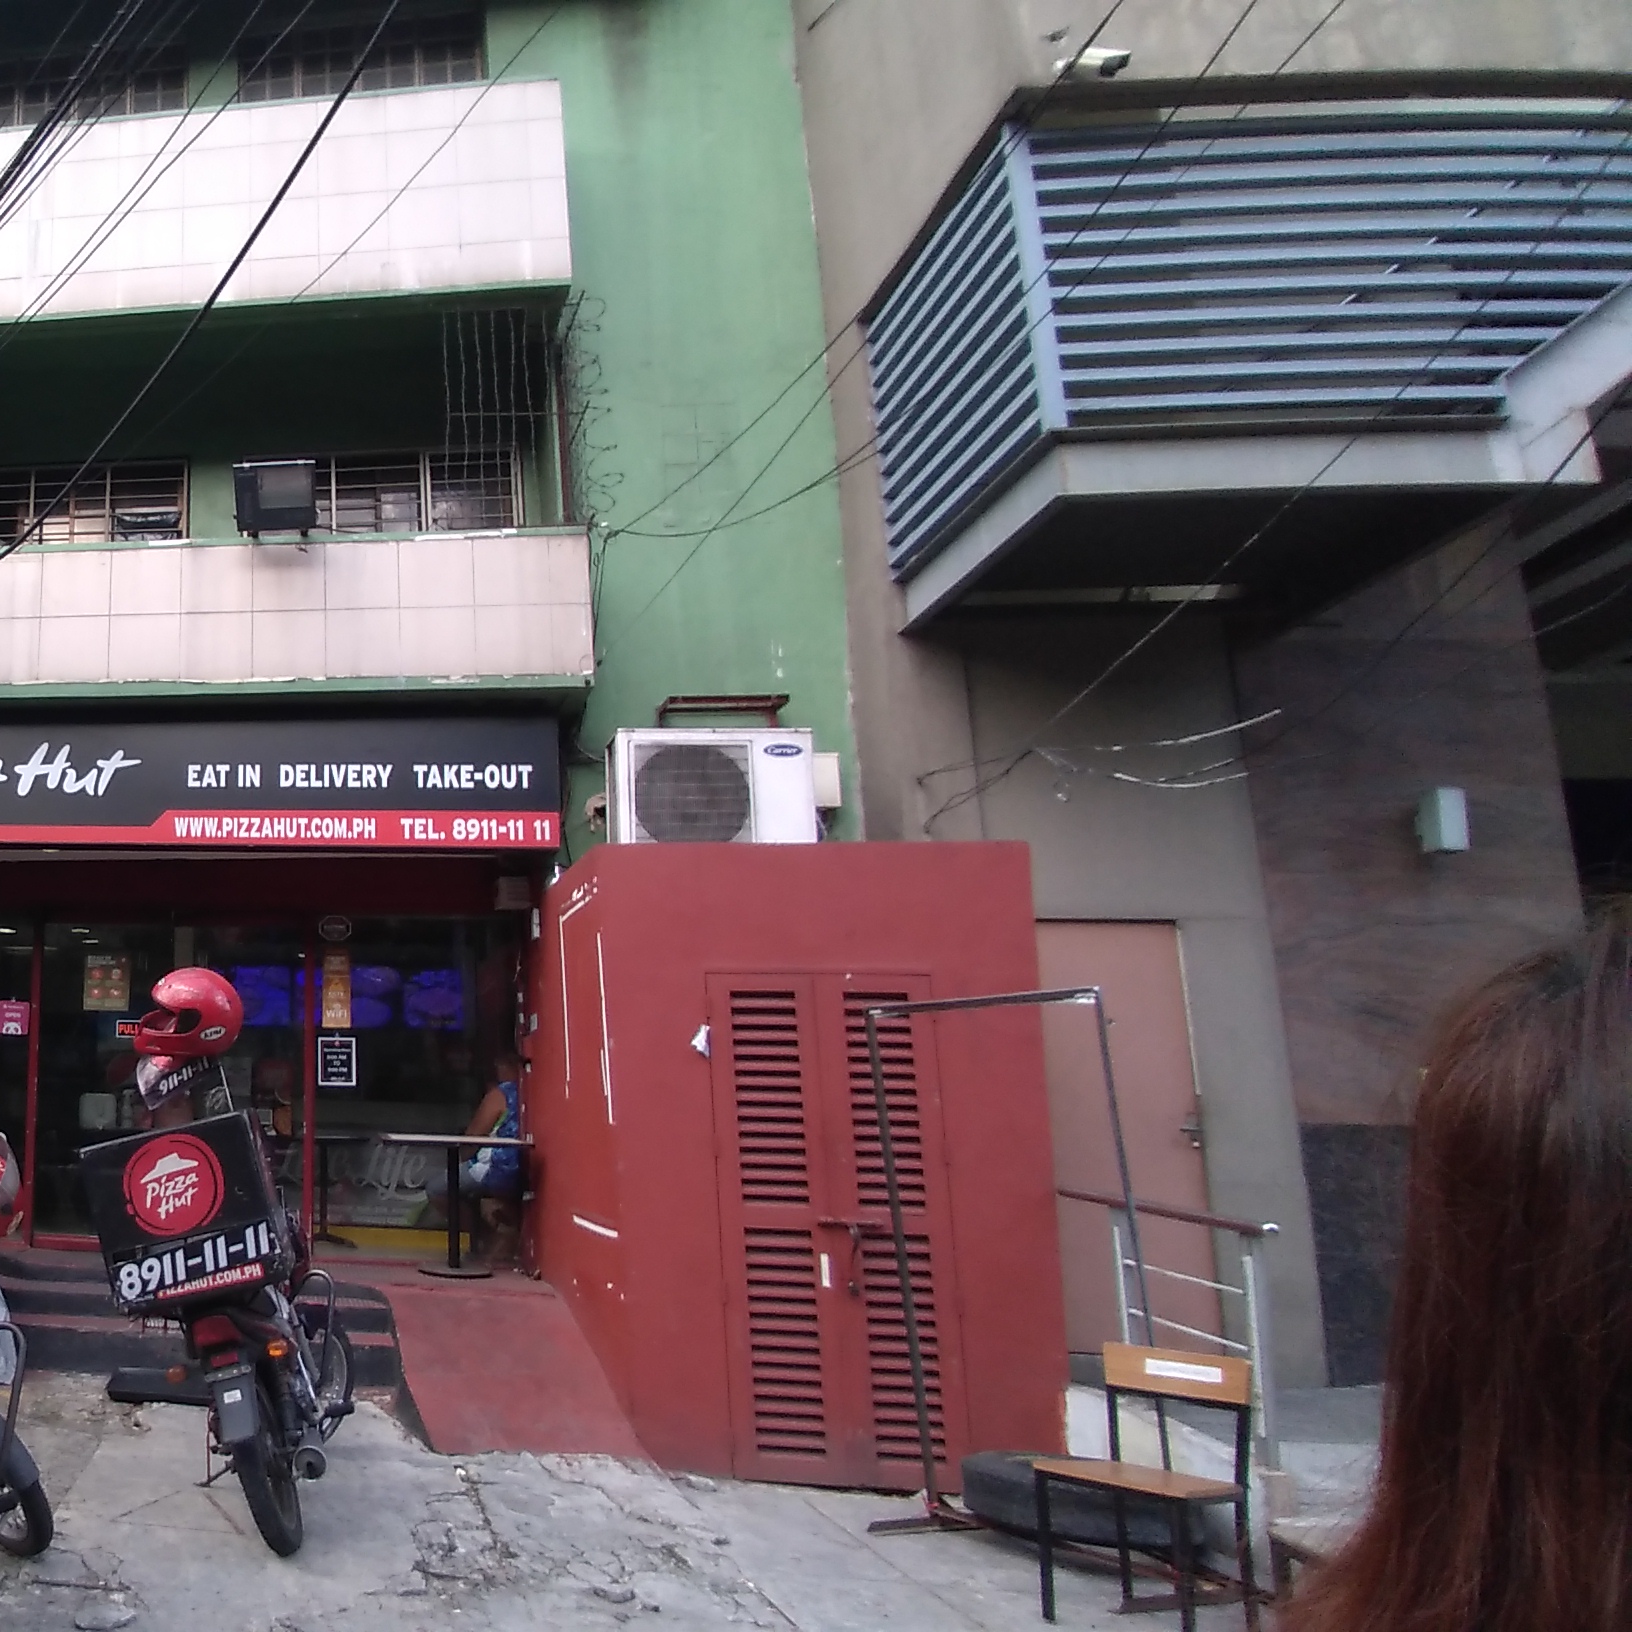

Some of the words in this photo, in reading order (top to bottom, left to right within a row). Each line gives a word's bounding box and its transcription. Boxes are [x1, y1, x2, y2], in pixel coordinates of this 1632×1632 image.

[766, 745, 799, 756] Carrier
[14, 742, 143, 797] Hut
[186, 763, 230, 788] EAT
[237, 763, 262, 788] IN
[278, 763, 394, 789] DELIVERY
[412, 764, 534, 790] TAKE-OUT
[173, 816, 377, 839] WWW.PIZZAHUT.COM.PH
[400, 818, 446, 840] TEL.
[452, 819, 525, 841] 8911-11
[158, 1056, 209, 1096] 911-11-11
[145, 1170, 199, 1209] Pizza
[157, 1186, 199, 1220] Hut
[118, 1221, 271, 1301] 8911-11-11
